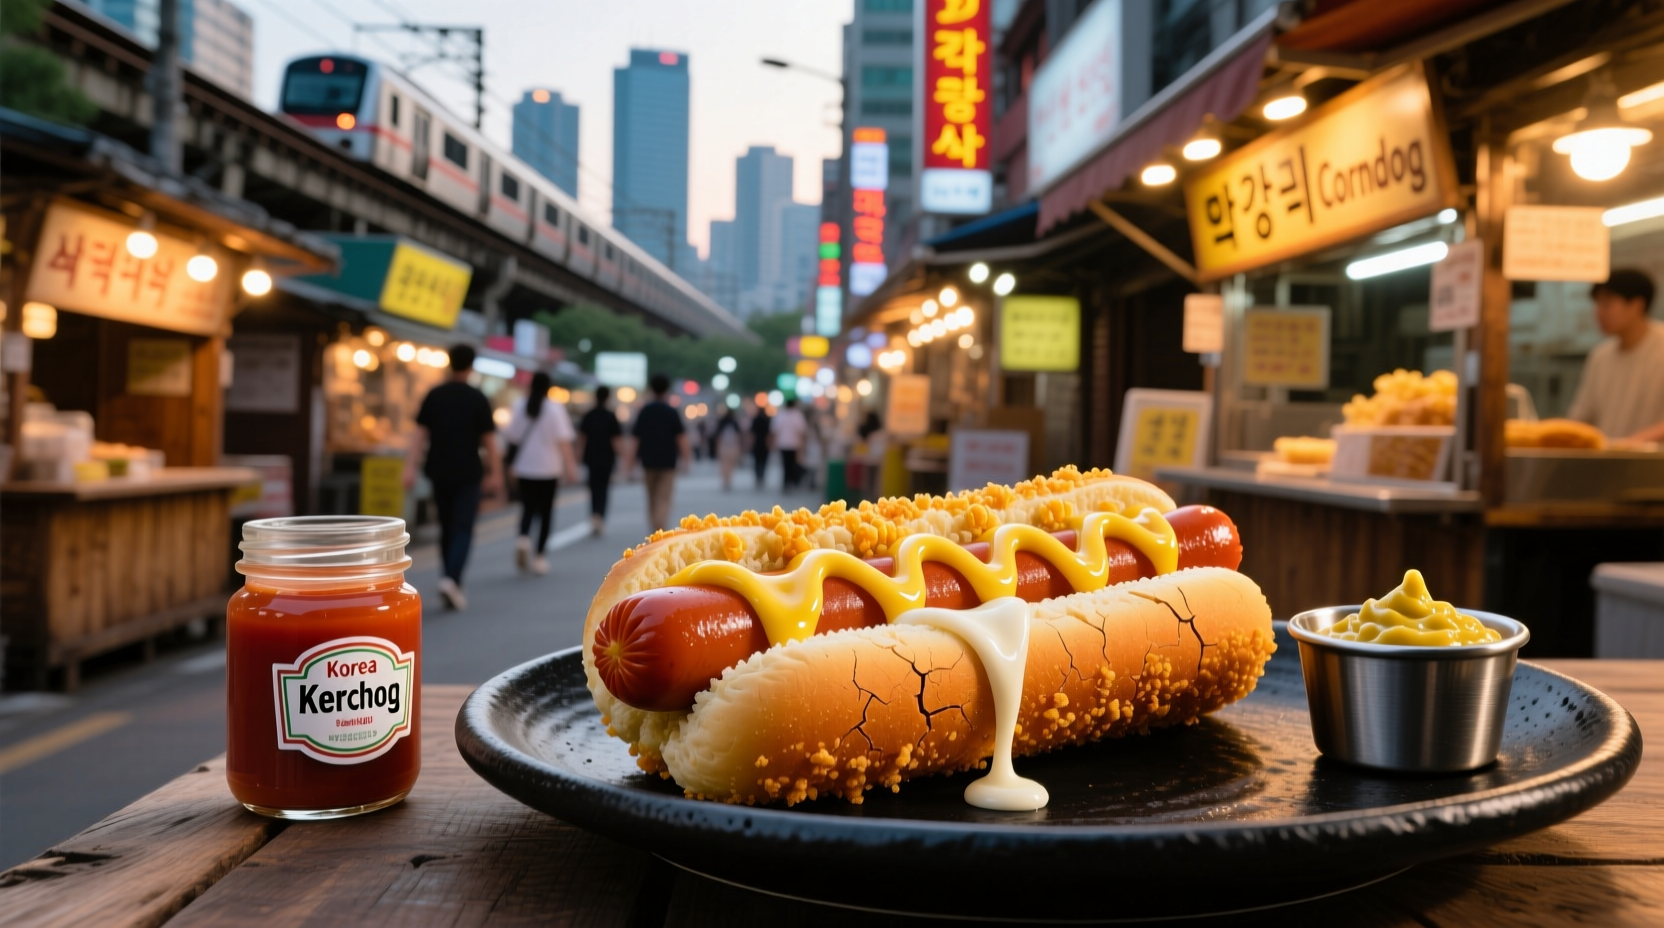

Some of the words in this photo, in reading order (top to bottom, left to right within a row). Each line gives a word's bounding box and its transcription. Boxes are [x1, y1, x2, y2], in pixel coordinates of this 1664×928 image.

[1319, 138, 1426, 208] Corndog
[327, 659, 377, 678] Korea
[299, 681, 400, 714] Kerchog
